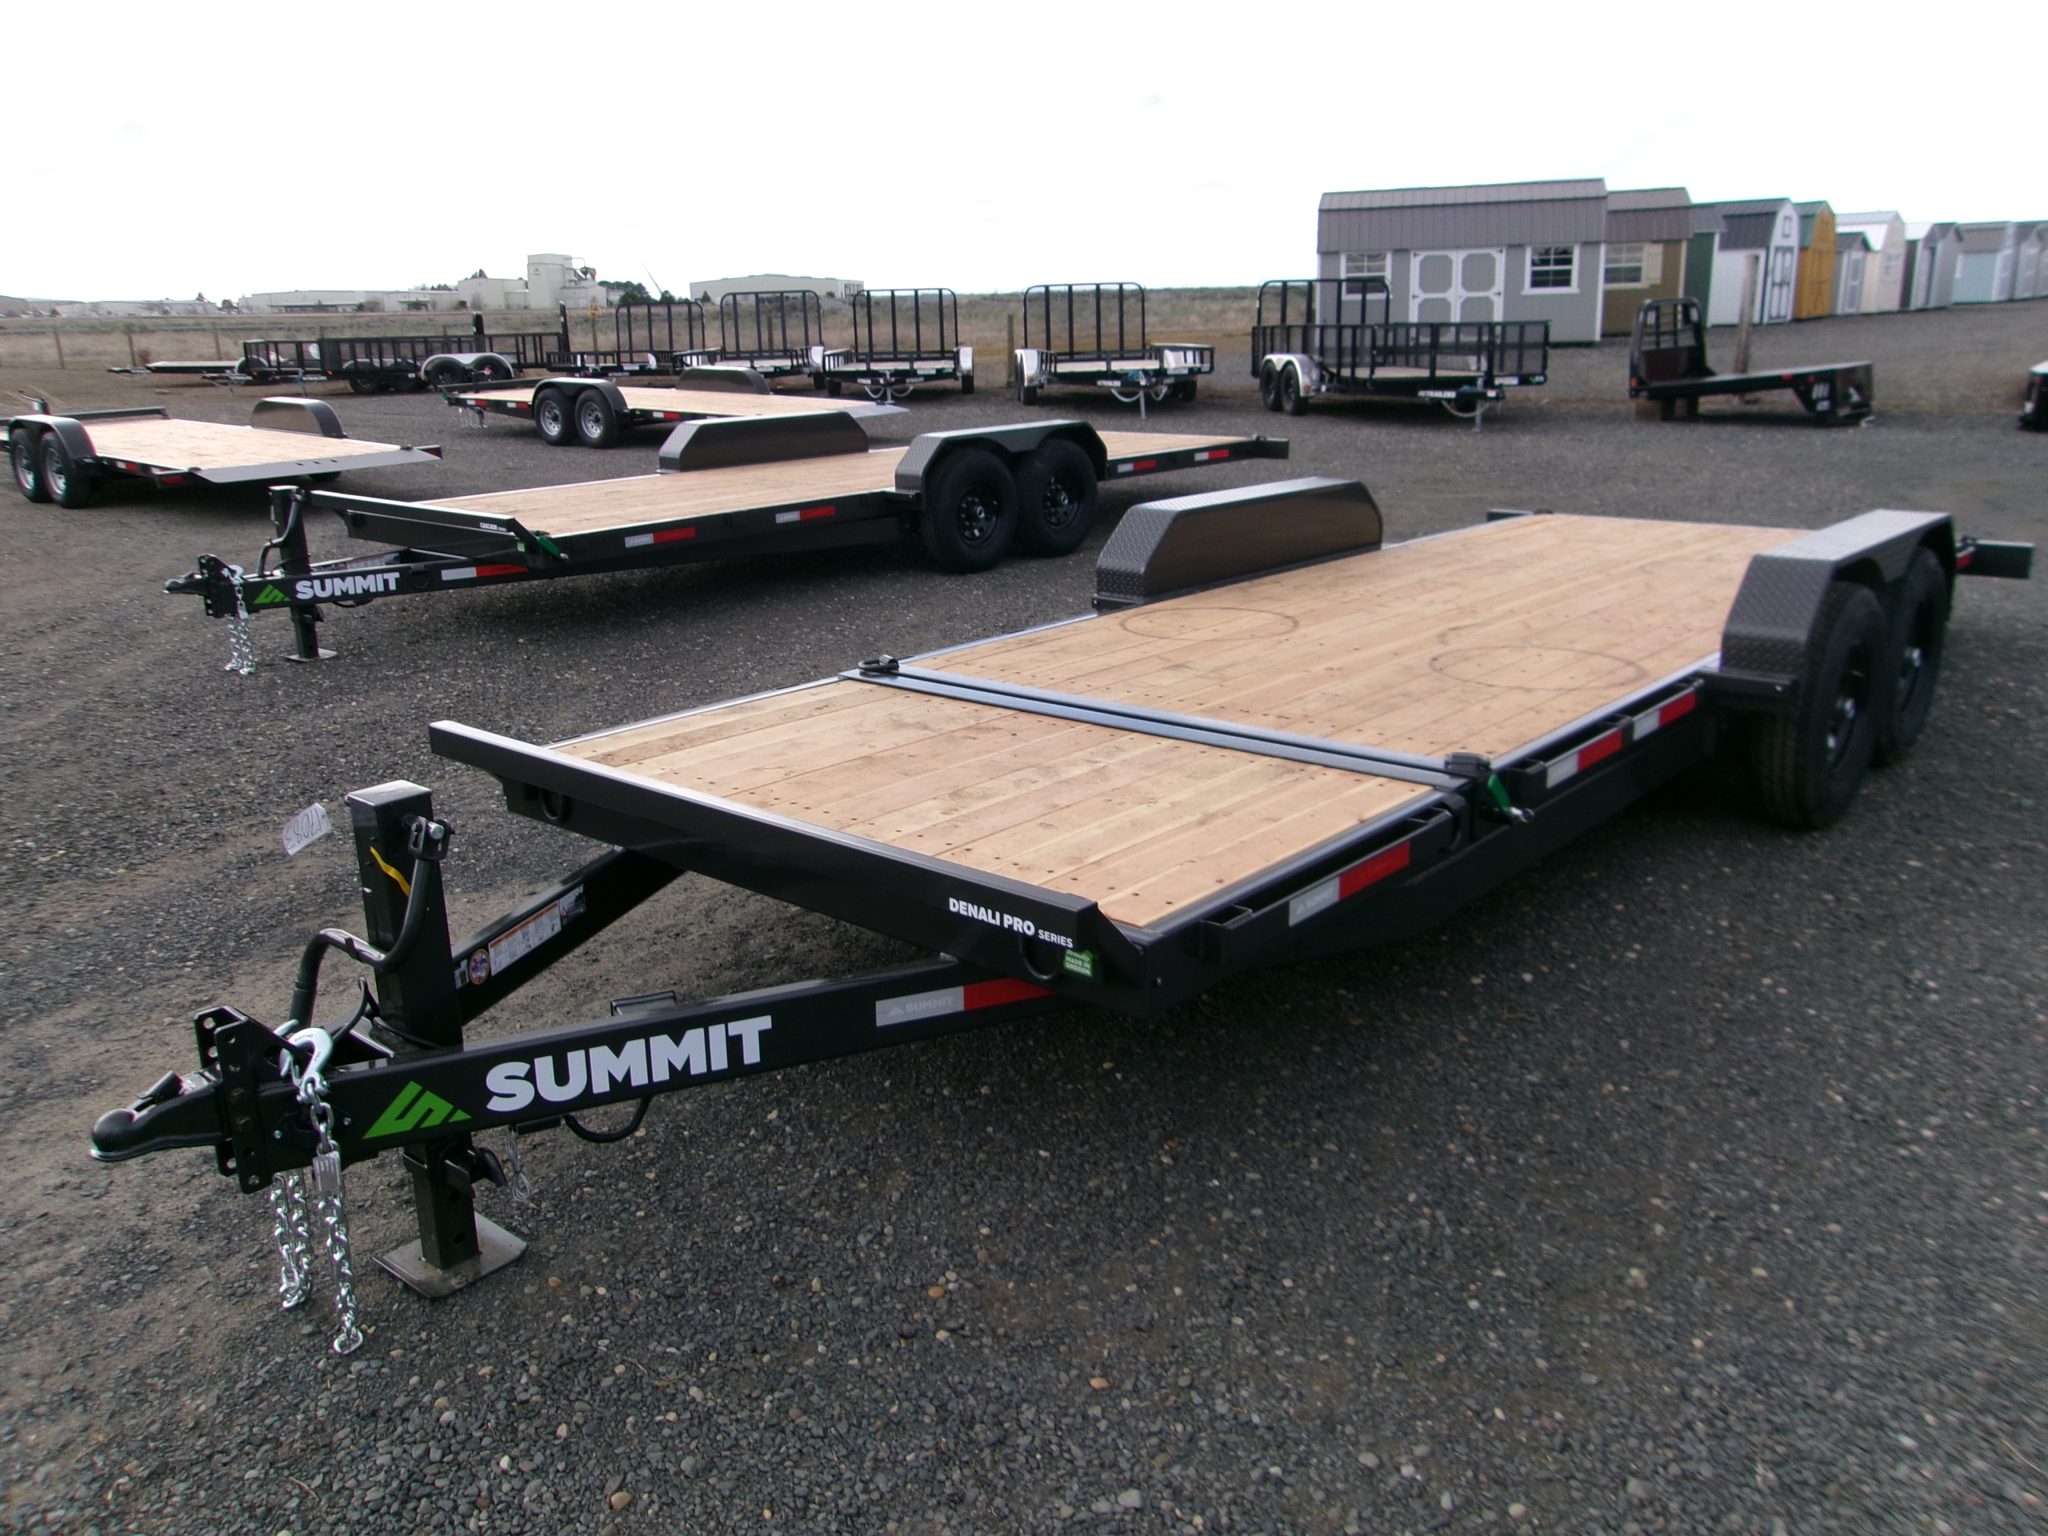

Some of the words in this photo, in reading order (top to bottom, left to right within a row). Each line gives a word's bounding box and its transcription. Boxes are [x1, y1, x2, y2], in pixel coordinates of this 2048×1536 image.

[295, 571, 400, 600] SUMMIT
[949, 897, 1000, 926] DENALI
[1003, 913, 1035, 937] PRO
[1038, 929, 1073, 948] SERIES
[905, 996, 955, 1013] SUMMIT
[485, 1015, 772, 1112] SUMMIT
